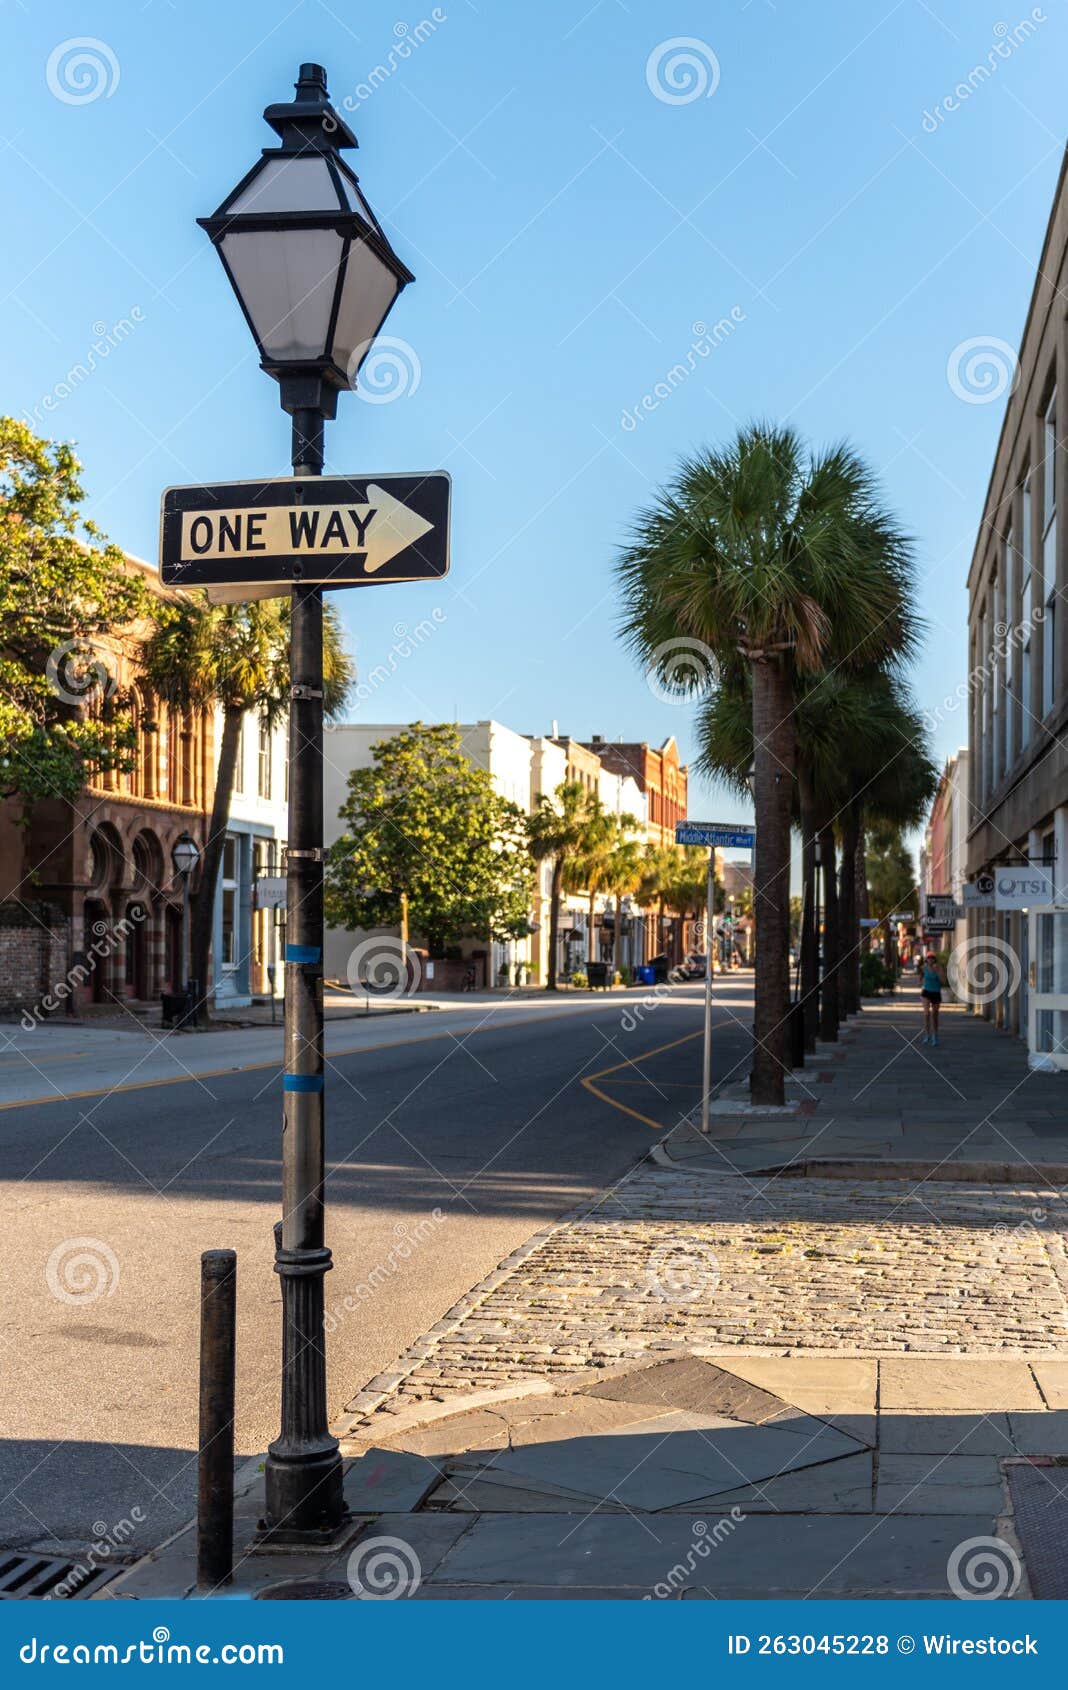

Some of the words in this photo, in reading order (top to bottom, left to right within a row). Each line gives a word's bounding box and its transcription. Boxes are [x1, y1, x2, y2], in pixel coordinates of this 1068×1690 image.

[190, 513, 267, 554] ONE
[289, 509, 378, 548] WAY
[679, 831, 703, 844] Middle
[704, 832, 734, 846] Atlantic
